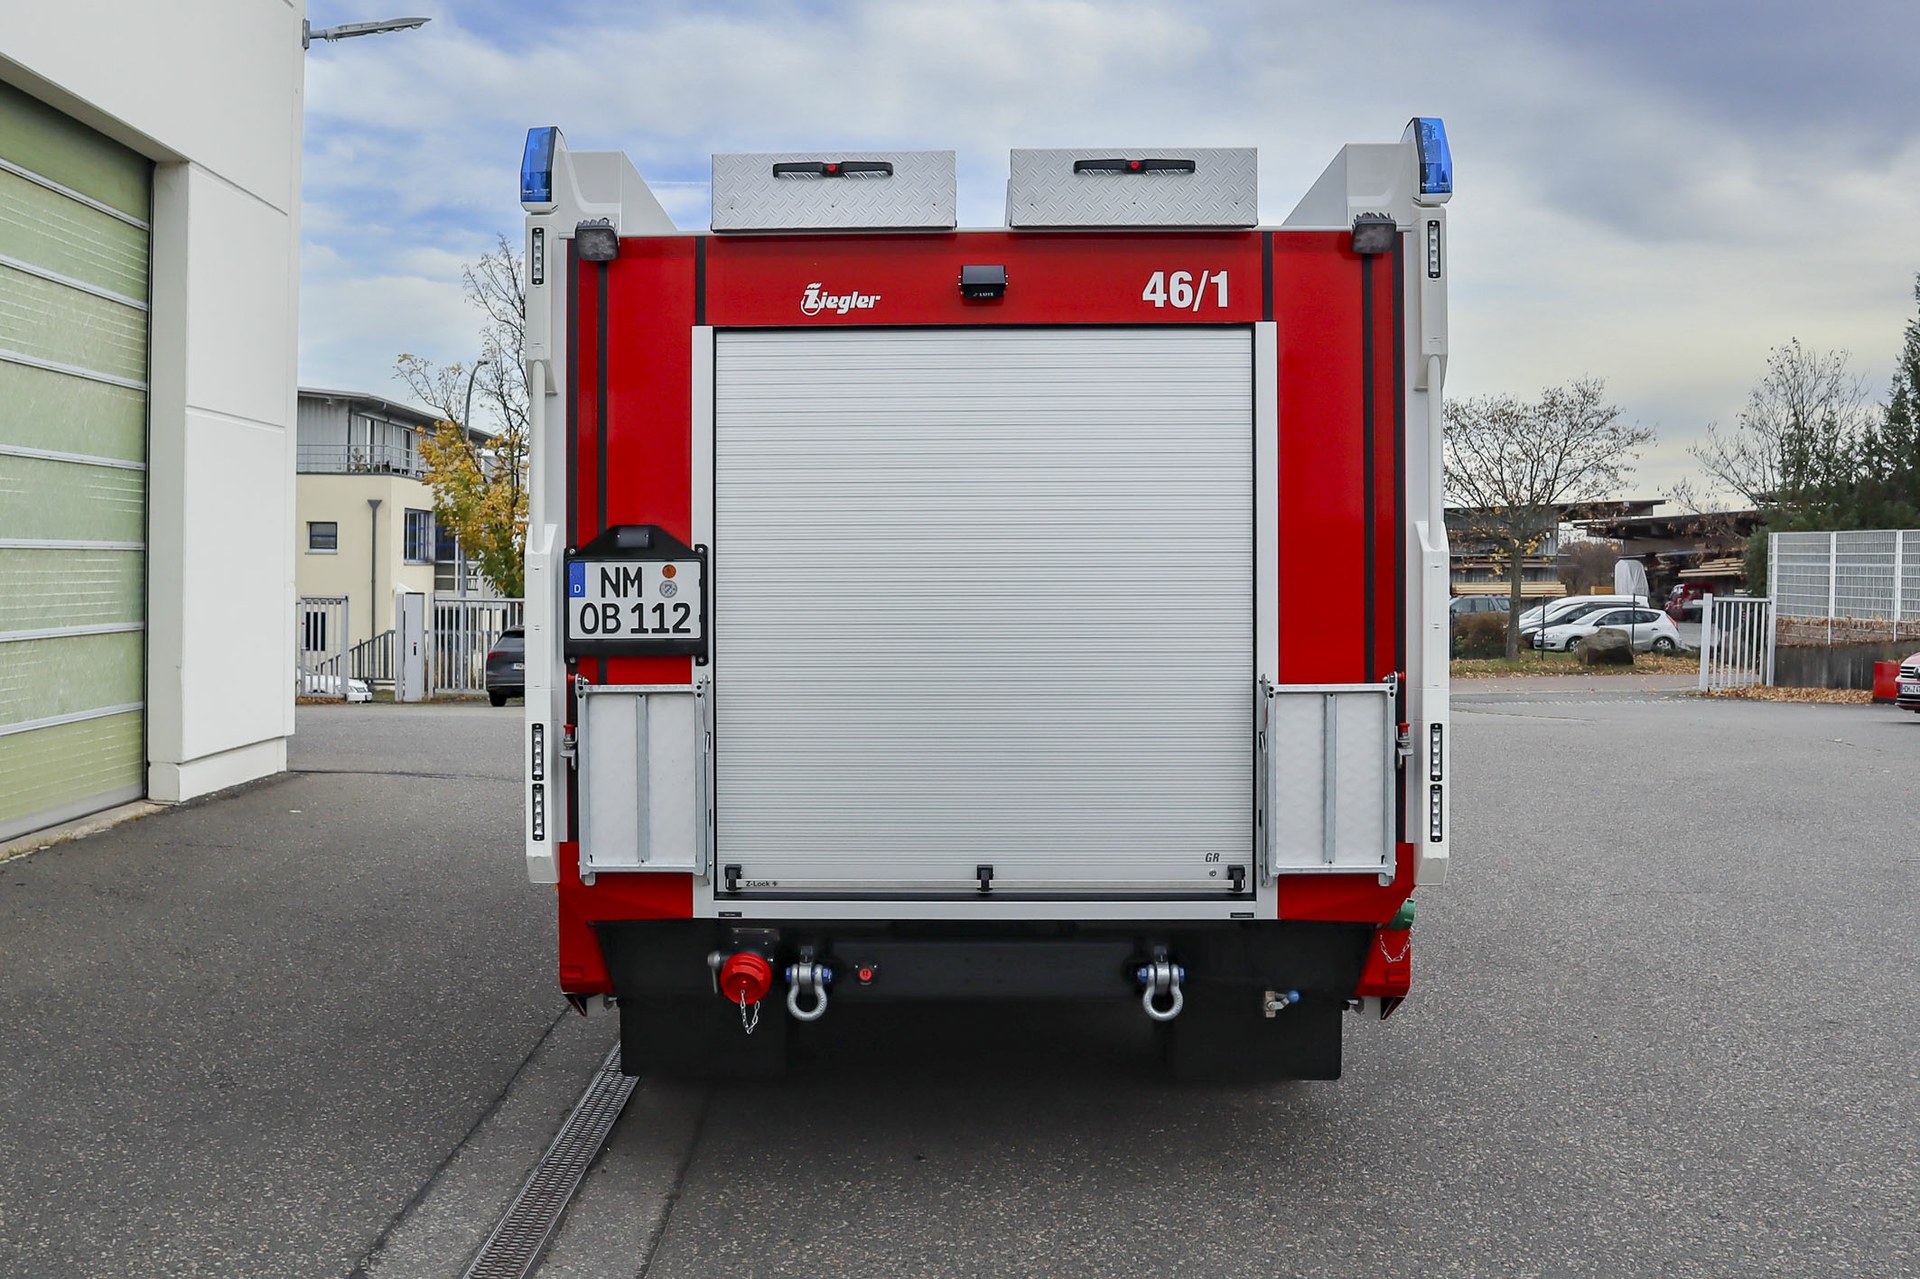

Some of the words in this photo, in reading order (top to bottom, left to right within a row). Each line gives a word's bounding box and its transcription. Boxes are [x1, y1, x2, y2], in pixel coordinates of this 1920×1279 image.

[801, 282, 881, 316] Ziegler
[1142, 269, 1229, 312] 46/1
[574, 584, 582, 594] D
[601, 567, 642, 598] NM
[580, 602, 621, 634] OB
[630, 602, 691, 634] 112
[1205, 852, 1220, 862] GR
